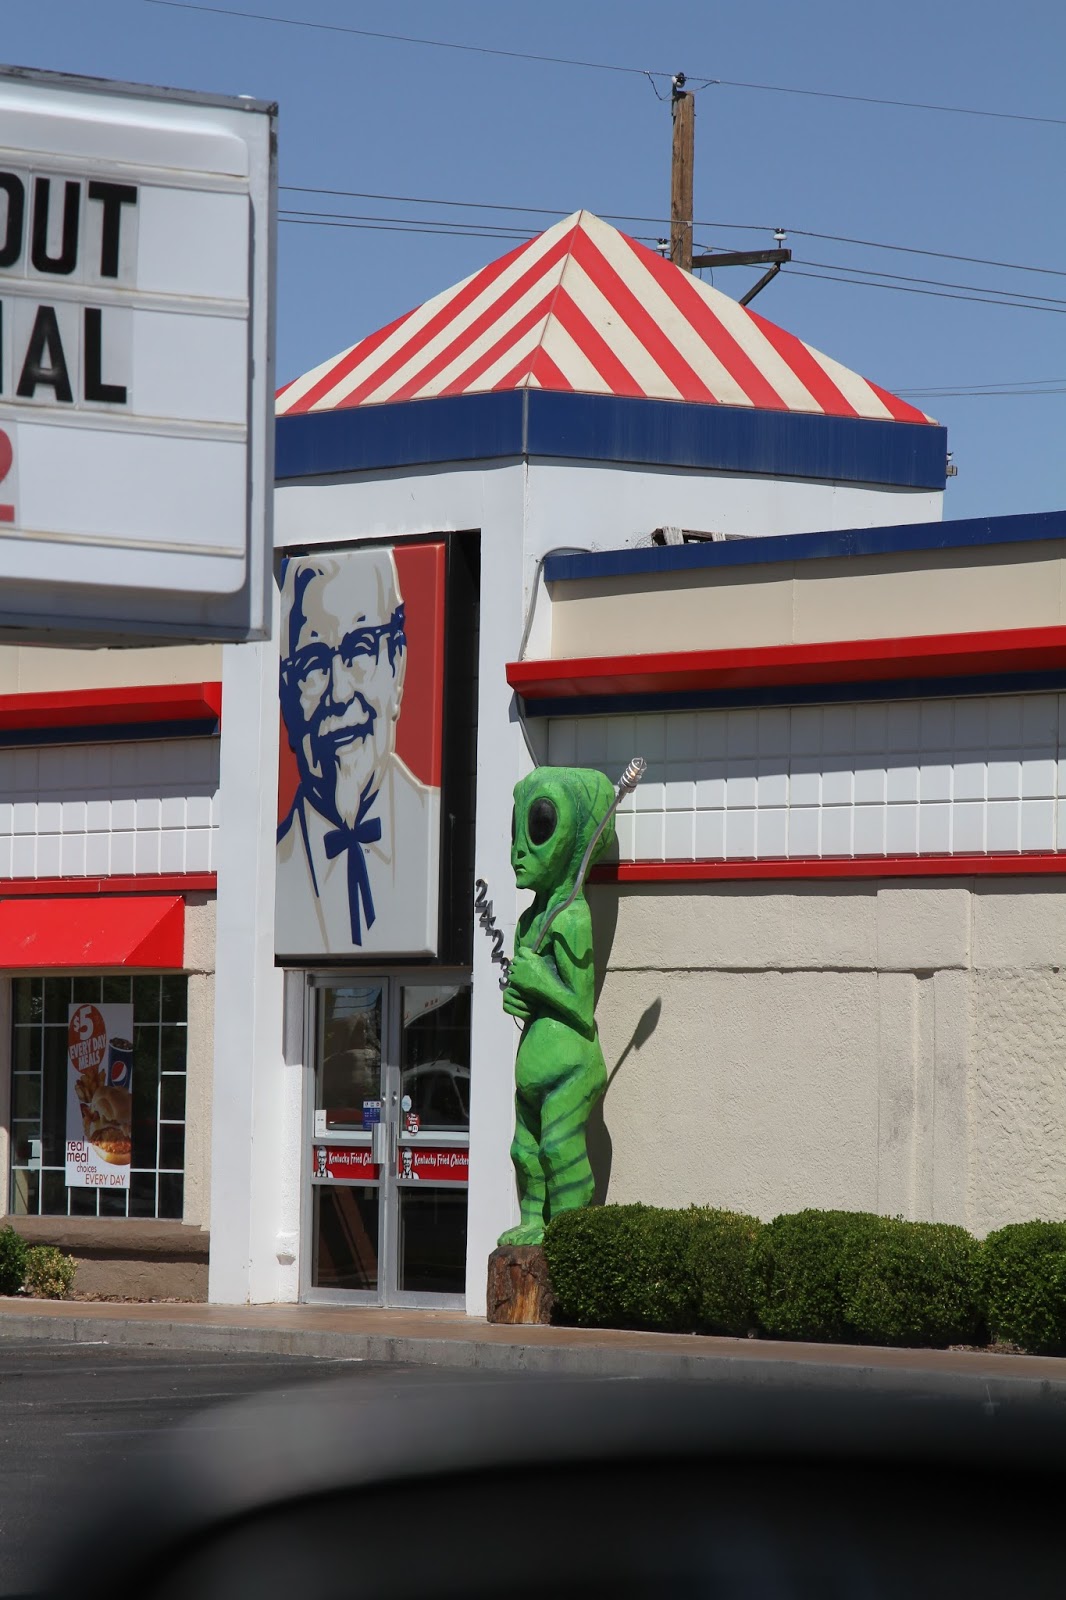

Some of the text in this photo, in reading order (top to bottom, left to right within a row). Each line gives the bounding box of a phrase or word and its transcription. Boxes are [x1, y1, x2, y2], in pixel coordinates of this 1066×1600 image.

[0, 302, 128, 404] AL
[73, 1005, 94, 1041] $5
[69, 1034, 106, 1060] EVERY DAY
[78, 1050, 101, 1071] MEALS
[67, 1136, 85, 1152] real
[66, 1147, 89, 1162] meal
[328, 1151, 350, 1165] Kentucky
[350, 1152, 363, 1165] Fried
[414, 1153, 436, 1167] Kentucky
[437, 1153, 450, 1167] Fried
[76, 1162, 97, 1173] choices
[85, 1174, 126, 1186] EVERY DAY
